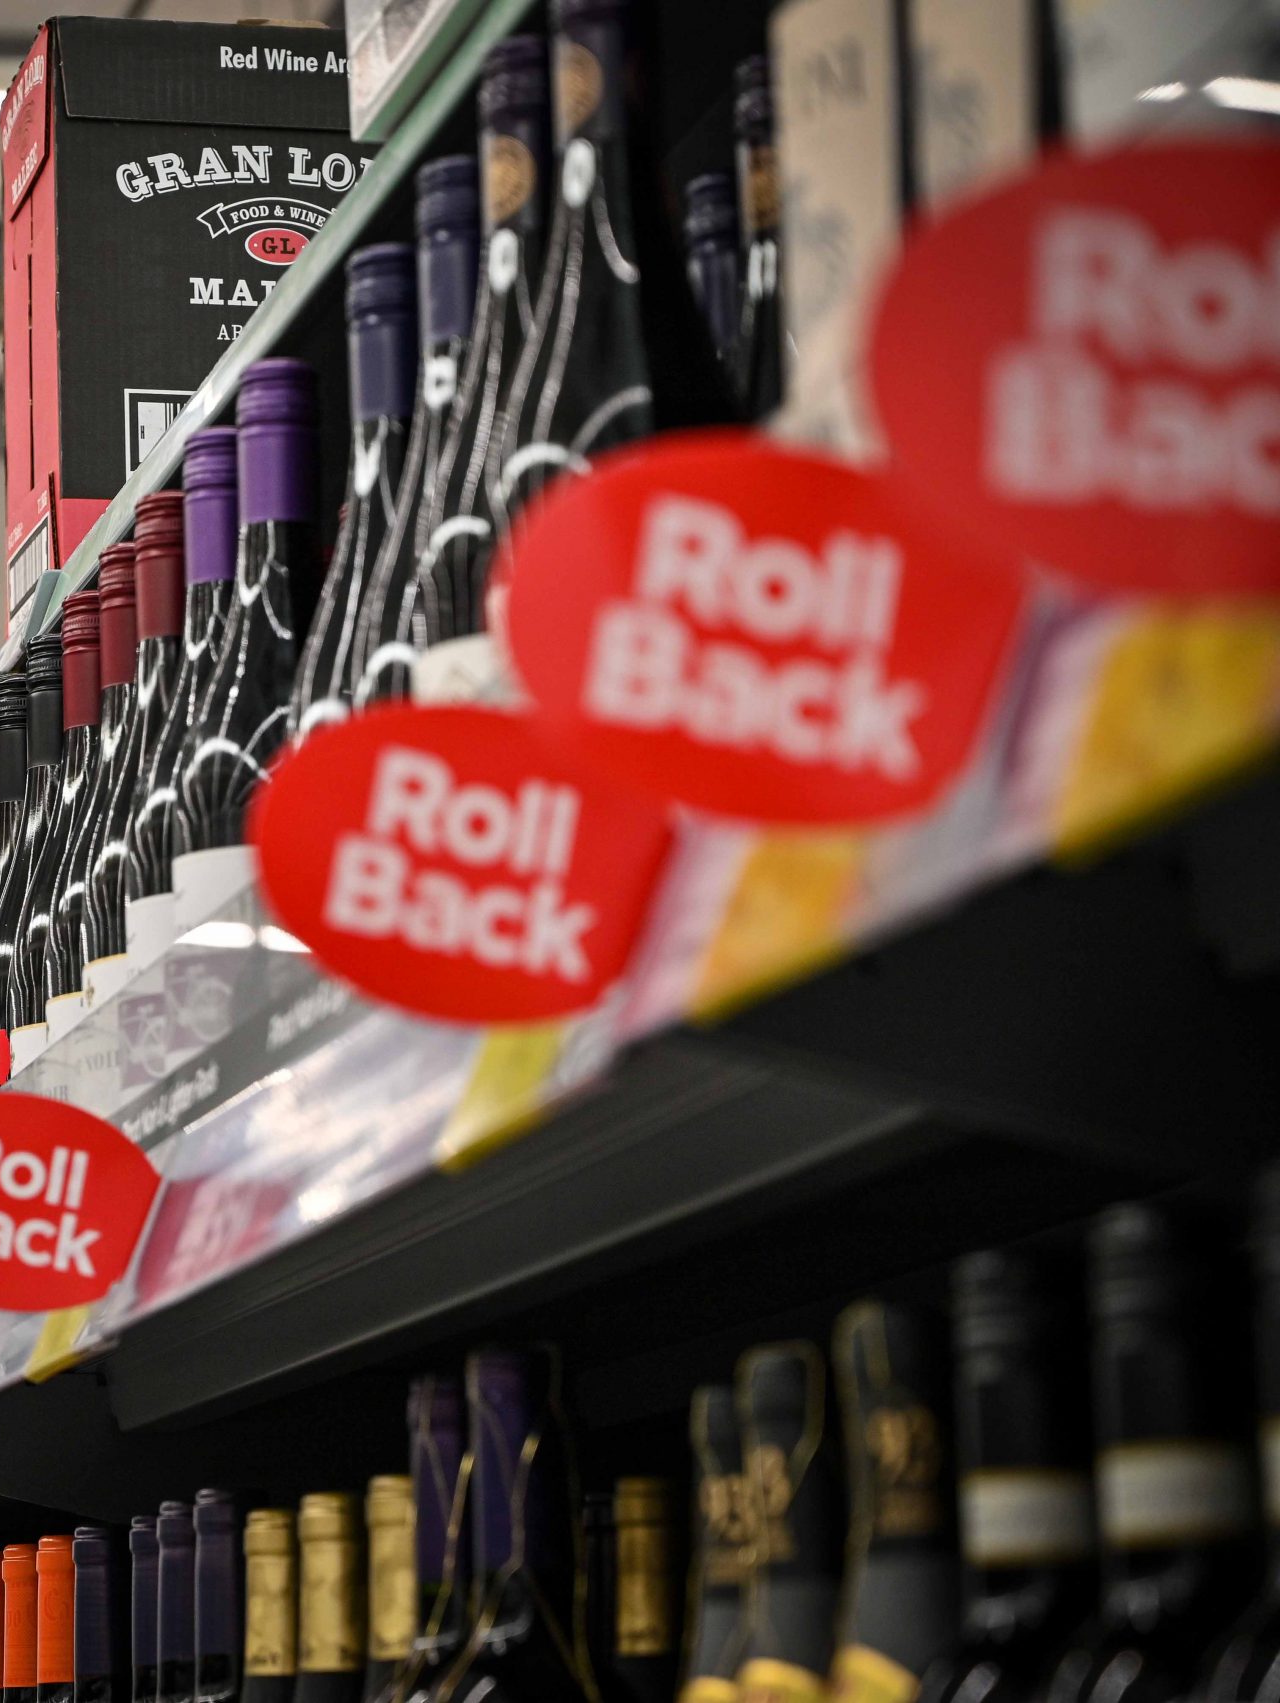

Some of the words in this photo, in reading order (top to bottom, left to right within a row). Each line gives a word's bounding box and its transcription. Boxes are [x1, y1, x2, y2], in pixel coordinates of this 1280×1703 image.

[220, 46, 258, 69] Red
[264, 48, 318, 72] Wine
[116, 145, 272, 201] GRAN
[230, 205, 269, 224] FOOD
[273, 205, 285, 217] &
[290, 207, 326, 227] WINE
[261, 237, 296, 255] GL
[1032, 207, 1280, 370] Ro
[632, 495, 903, 650] Roll
[583, 603, 924, 780] Back
[370, 745, 580, 875] Roll
[325, 832, 597, 983] Back
